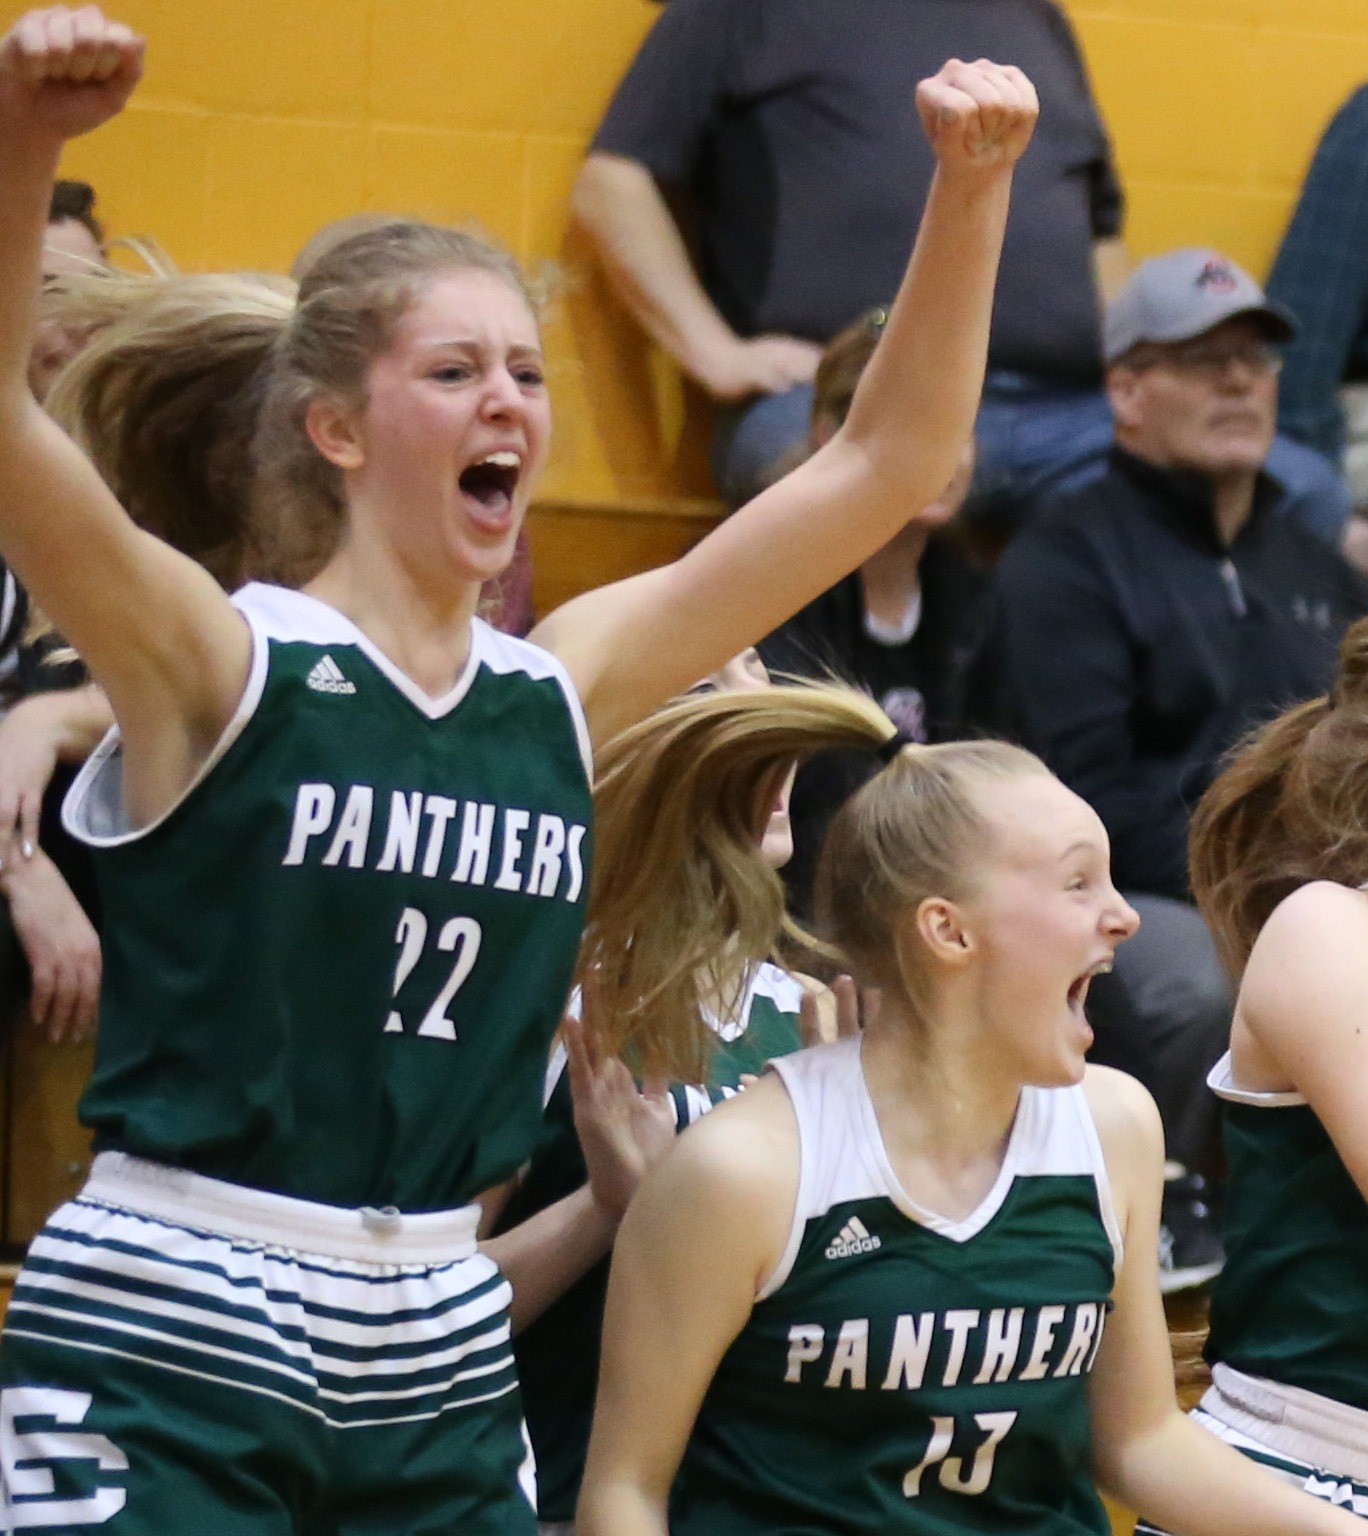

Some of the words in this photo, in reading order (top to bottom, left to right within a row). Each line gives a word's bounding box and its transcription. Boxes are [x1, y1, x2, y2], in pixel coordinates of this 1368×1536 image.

[383, 906, 482, 1041] 22
[825, 1236, 881, 1260] adidas
[784, 1302, 1106, 1391] PANTHER
